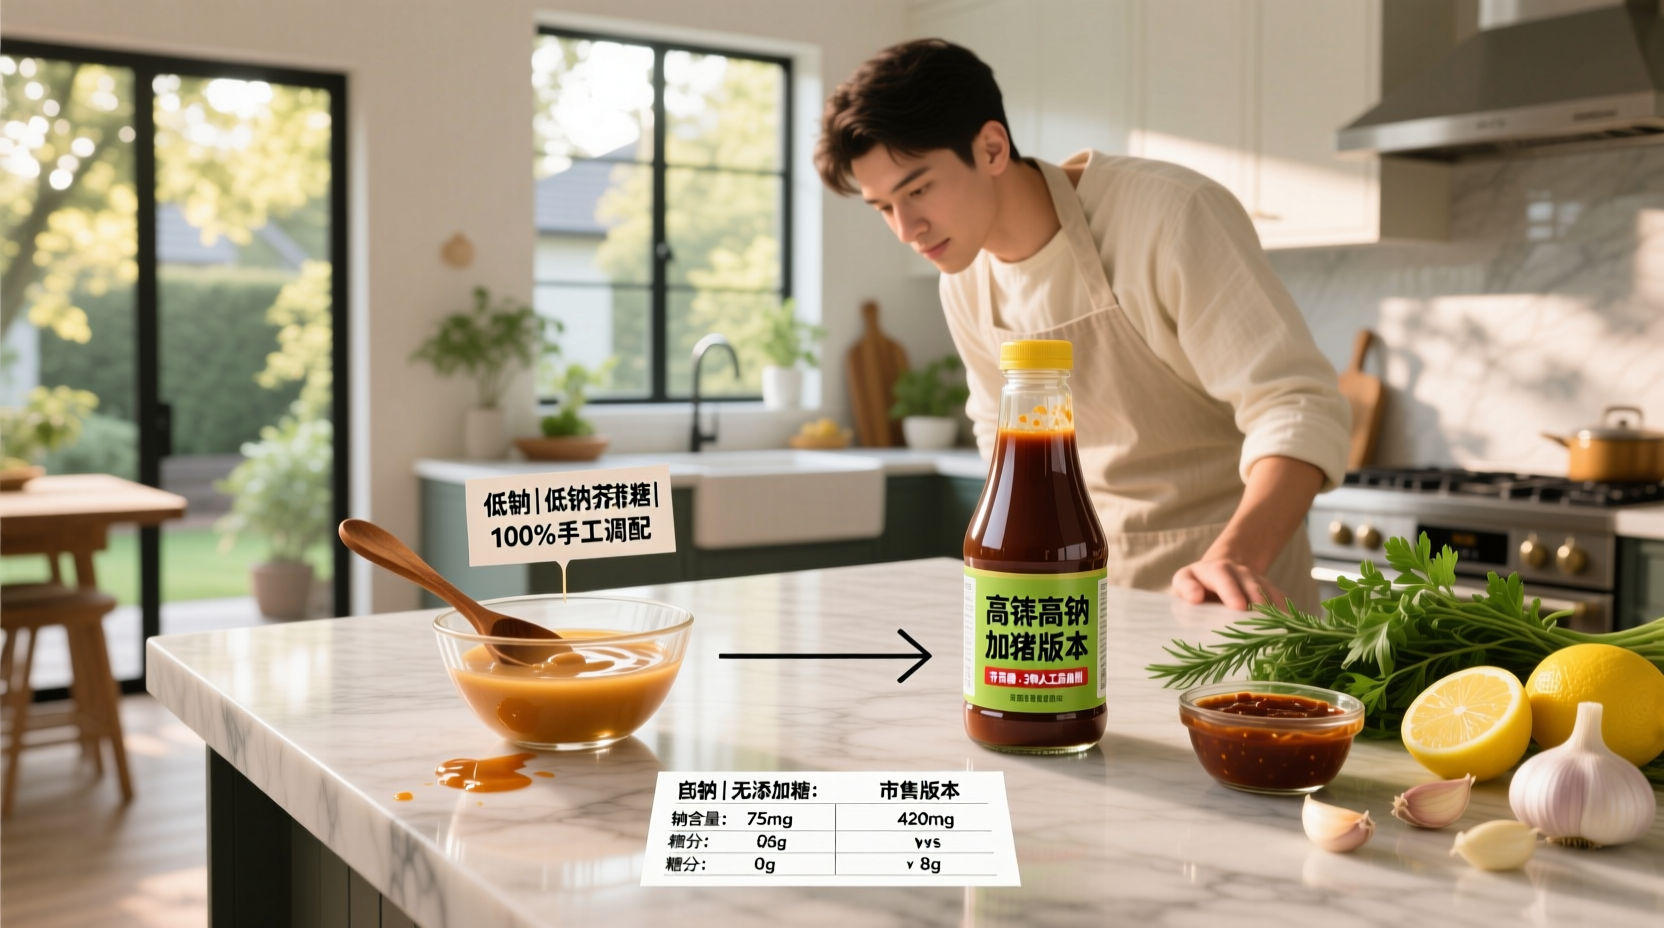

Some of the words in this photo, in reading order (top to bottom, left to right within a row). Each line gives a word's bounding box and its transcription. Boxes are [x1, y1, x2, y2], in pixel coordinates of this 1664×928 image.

[491, 516, 652, 548] 100%手工调配
[880, 780, 960, 800] 市售版本
[747, 811, 793, 829] 75mg
[897, 811, 955, 829] 420mg
[754, 857, 776, 874] 0g
[920, 857, 941, 874] 8g
